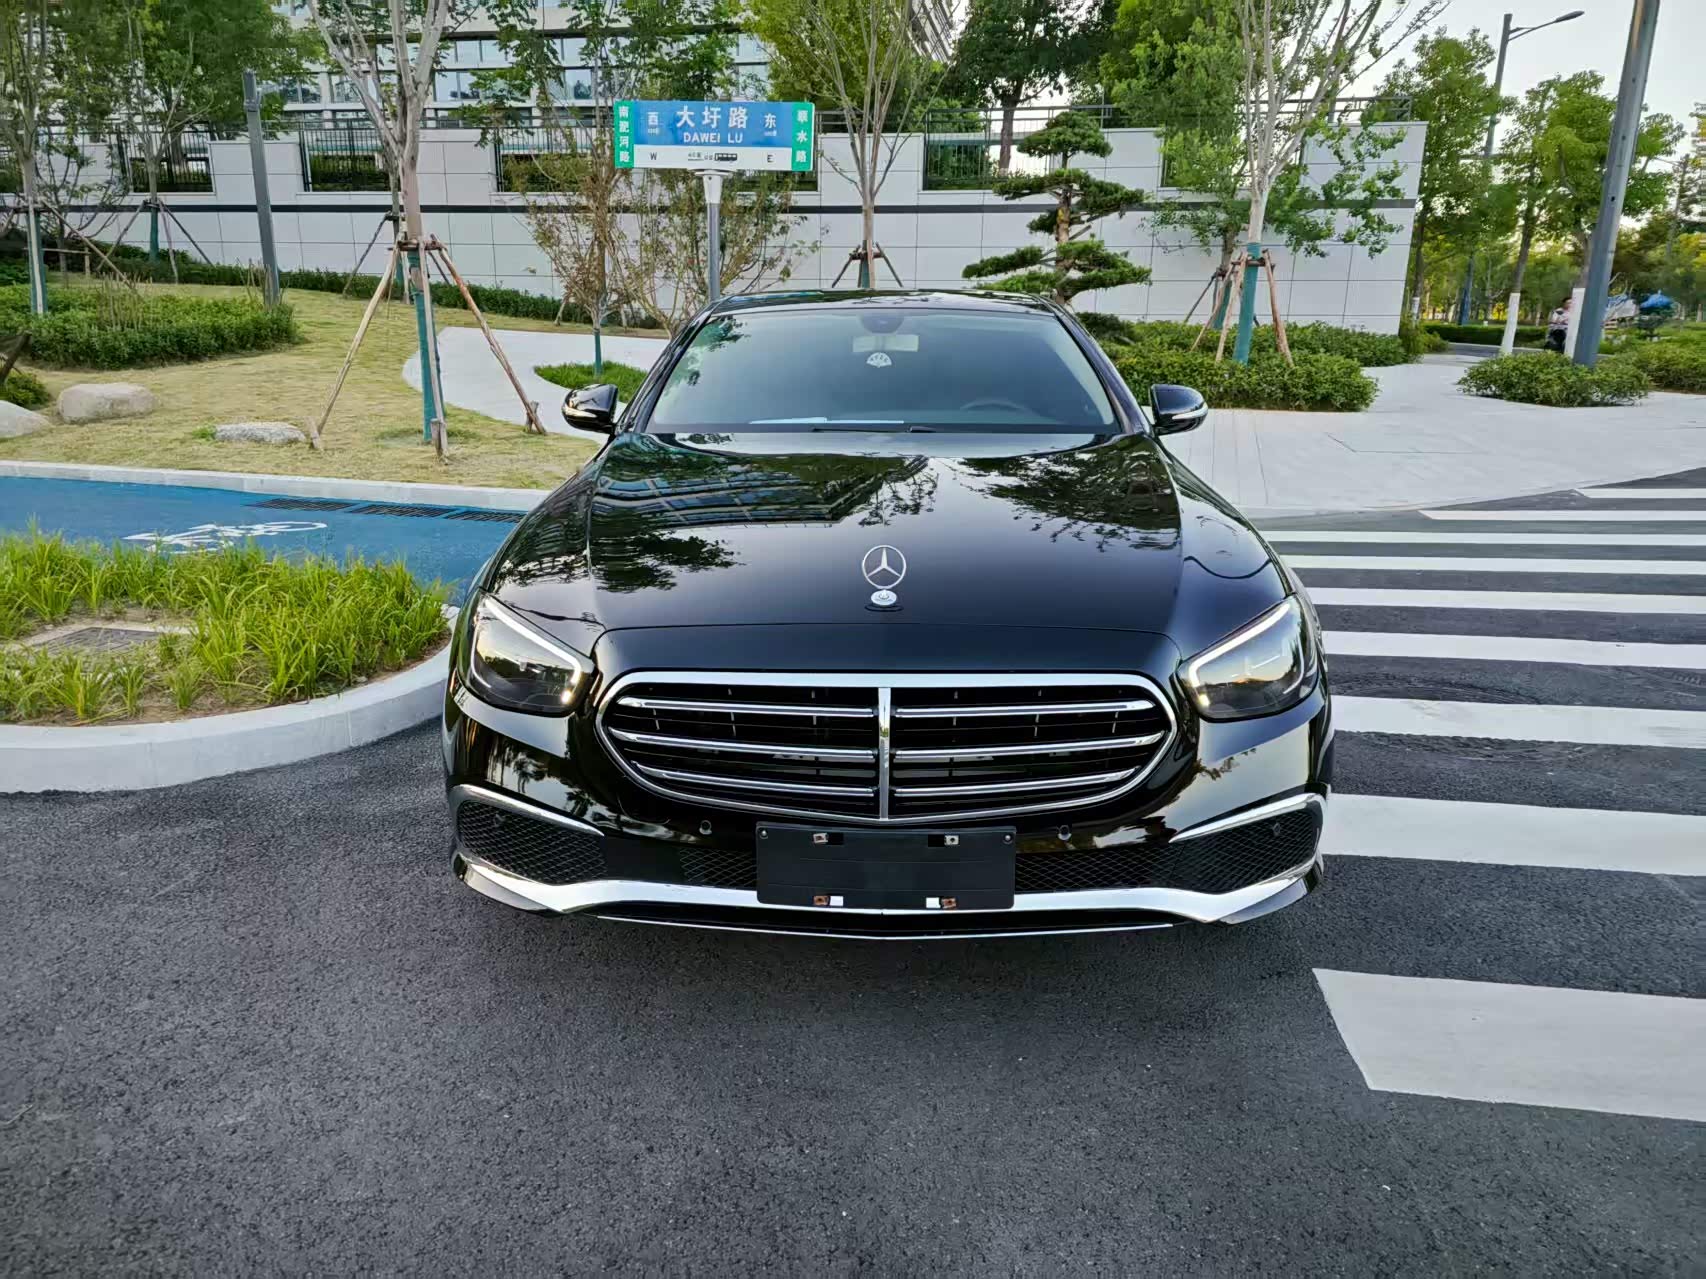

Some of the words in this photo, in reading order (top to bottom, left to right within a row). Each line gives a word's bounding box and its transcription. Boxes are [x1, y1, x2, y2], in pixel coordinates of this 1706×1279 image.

[676, 105, 748, 129] 大圩路
[764, 113, 777, 129] 东
[683, 132, 721, 143] DAWEI
[727, 132, 743, 144] LU
[650, 152, 657, 161] W
[767, 154, 774, 163] E
